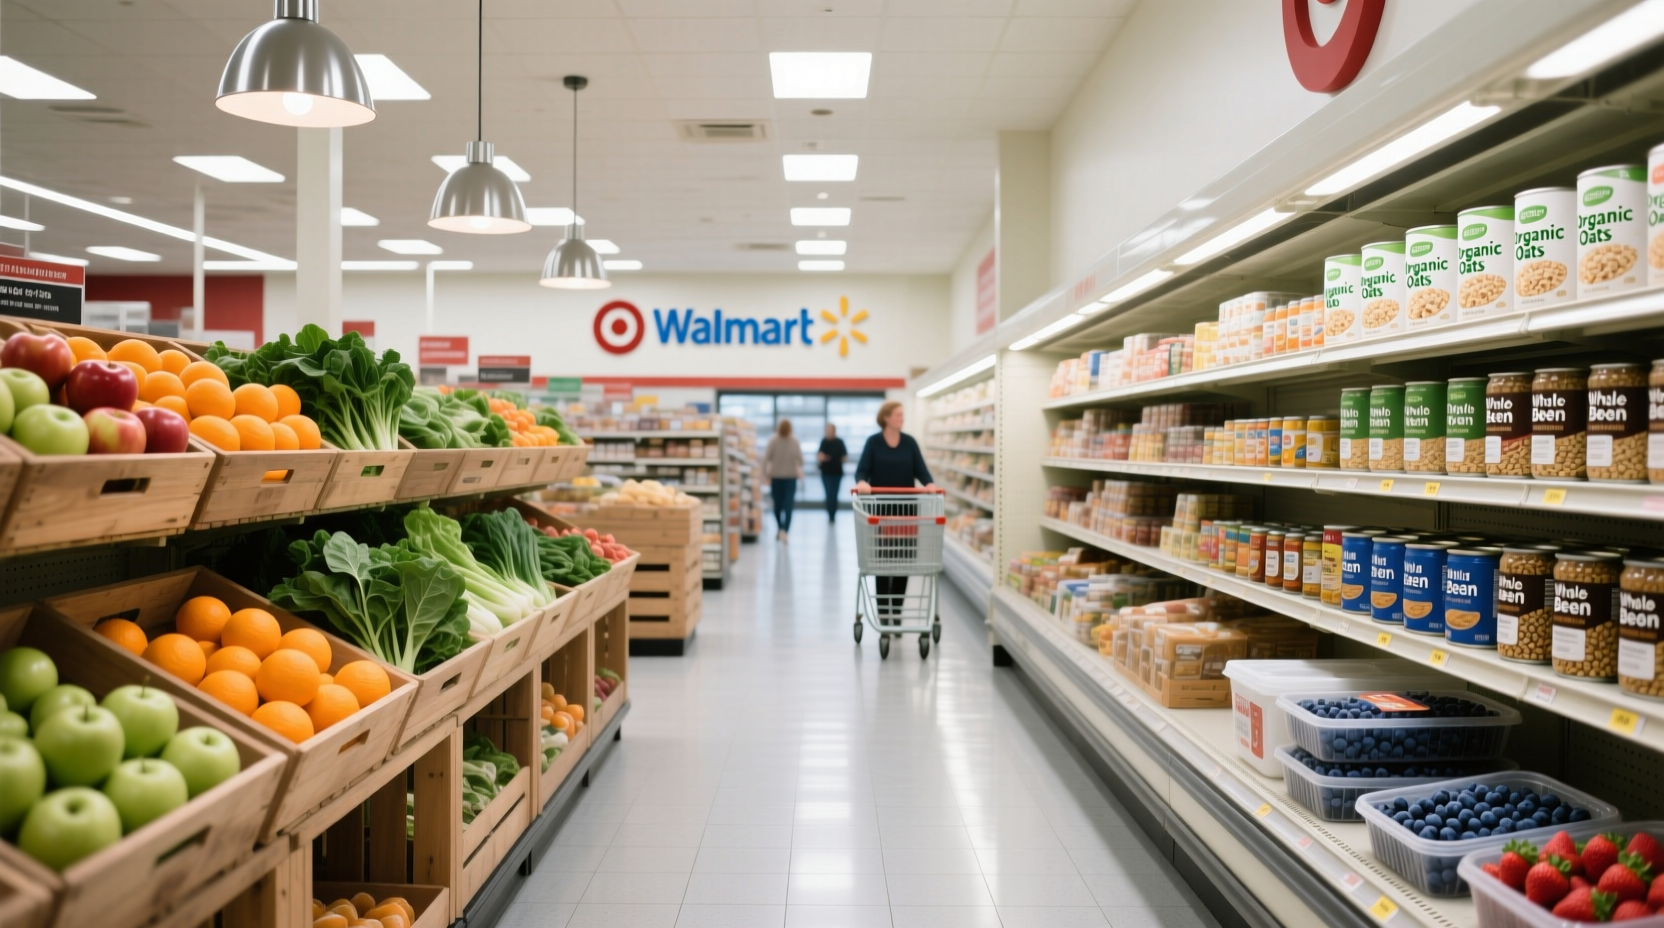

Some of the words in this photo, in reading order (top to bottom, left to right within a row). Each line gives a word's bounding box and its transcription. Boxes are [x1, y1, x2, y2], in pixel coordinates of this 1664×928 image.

[1516, 246, 1545, 261] Oats
[1406, 257, 1448, 276] rganic
[1459, 261, 1485, 275] Oats
[653, 309, 814, 346] Walmart
